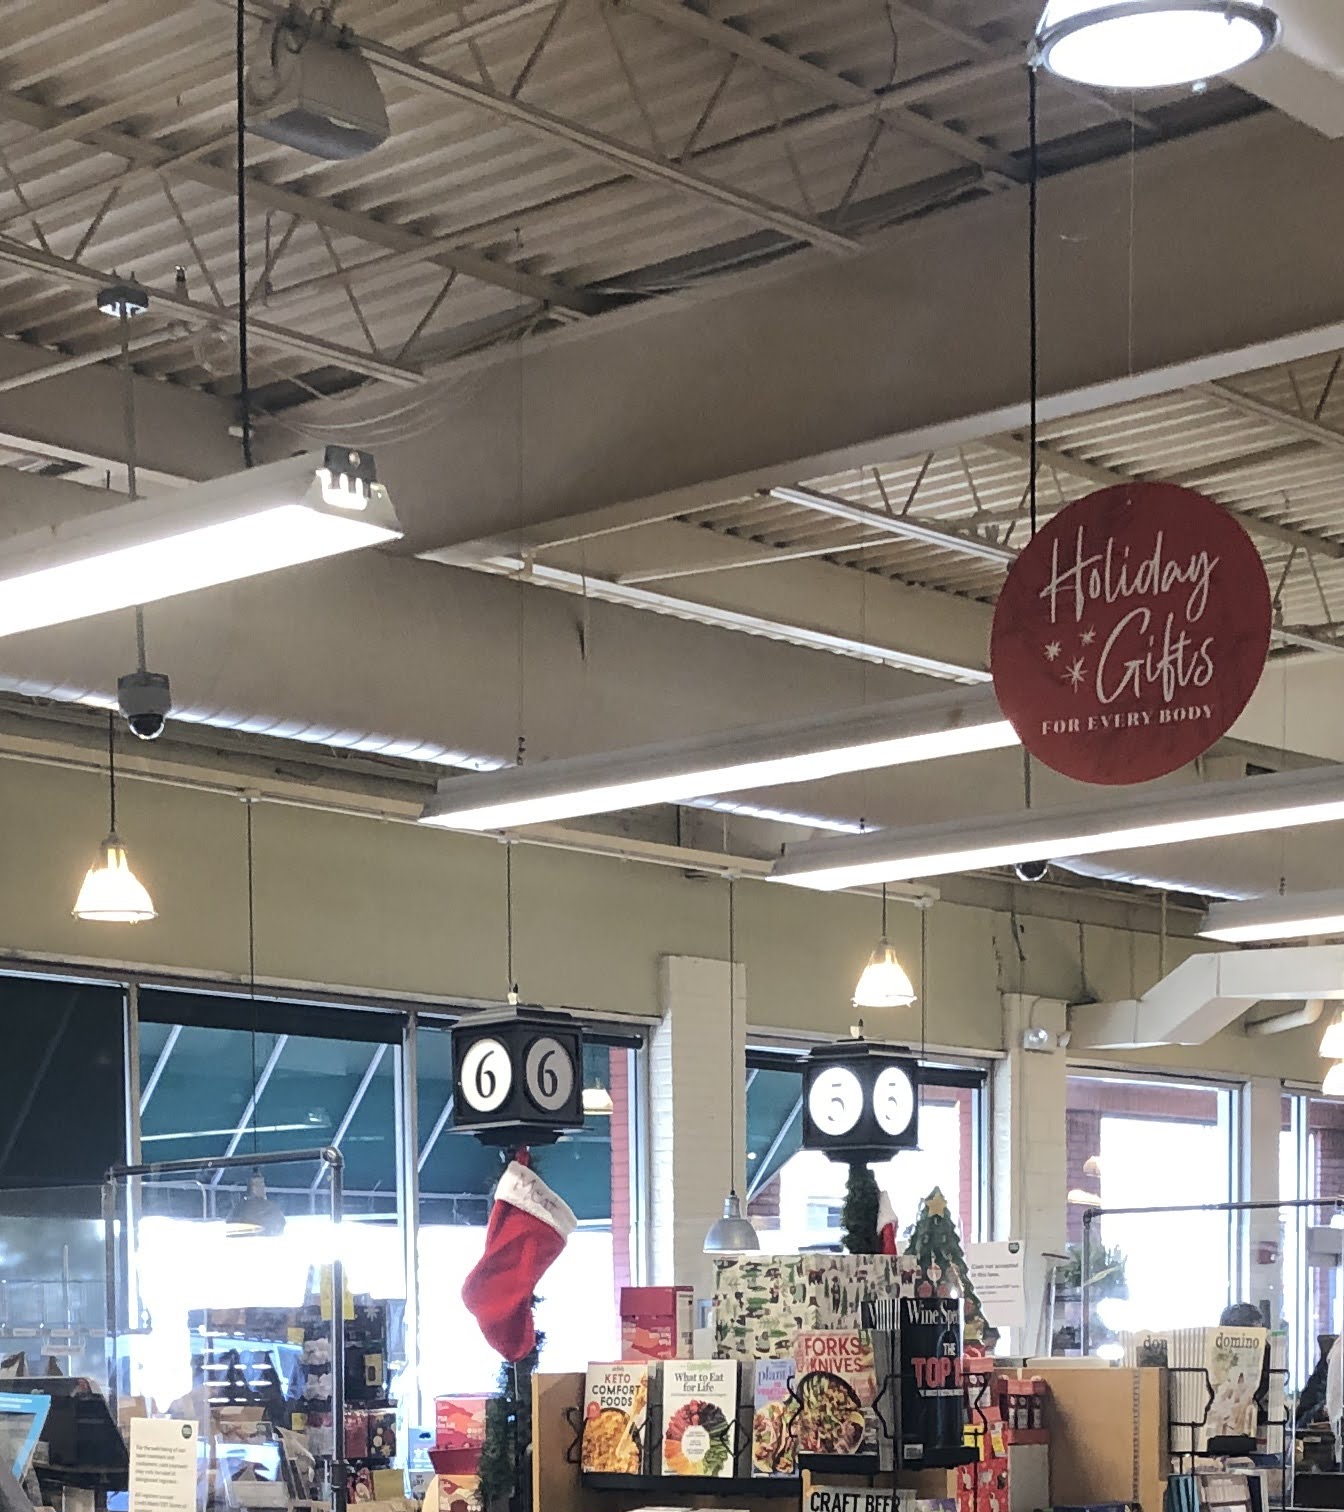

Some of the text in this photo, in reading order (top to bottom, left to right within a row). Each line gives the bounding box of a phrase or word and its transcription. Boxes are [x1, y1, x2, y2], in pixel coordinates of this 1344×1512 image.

[1040, 525, 1220, 623] Holiday
[1096, 607, 1215, 704] Gifts
[1042, 705, 1215, 736] FOR EVERY BODY
[475, 1050, 496, 1099] 6
[537, 1049, 558, 1098] 6
[827, 1083, 846, 1122] 5
[886, 1083, 899, 1122] 5
[907, 1300, 940, 1324] Wine
[804, 1337, 863, 1356] FORKS
[1215, 1332, 1260, 1349] domino
[674, 1372, 724, 1382] What to Eat
[810, 1358, 864, 1373] KNIVES
[911, 1357, 951, 1388] TOP
[592, 1385, 641, 1395] COMFORT
[605, 1374, 630, 1384] KETO
[683, 1382, 715, 1392] for Life
[600, 1397, 632, 1407] FOODS
